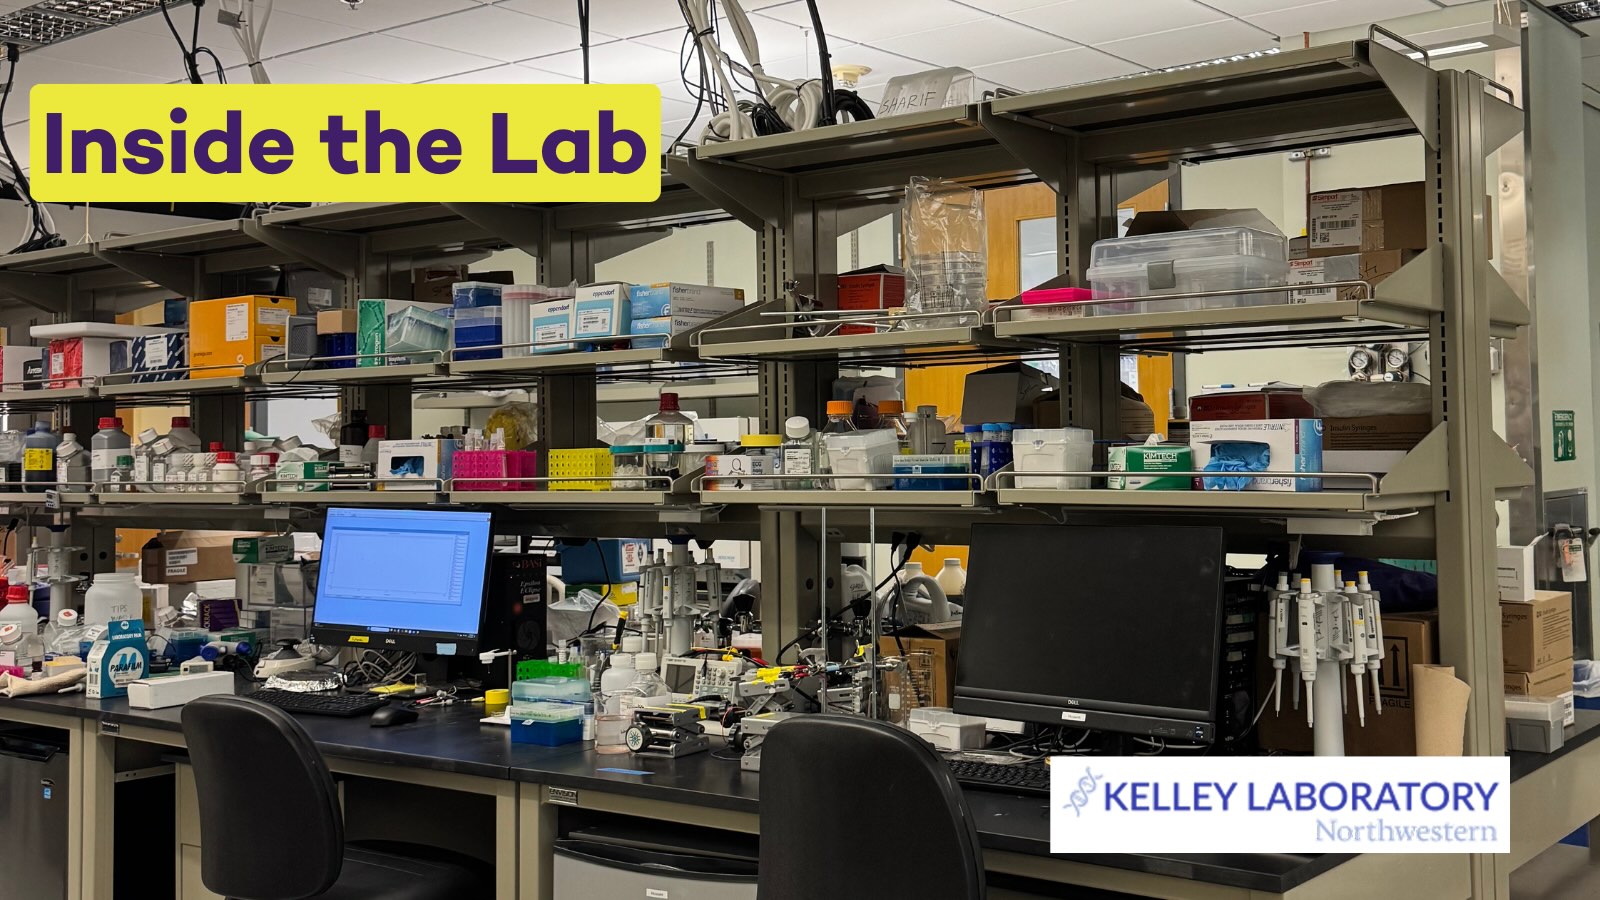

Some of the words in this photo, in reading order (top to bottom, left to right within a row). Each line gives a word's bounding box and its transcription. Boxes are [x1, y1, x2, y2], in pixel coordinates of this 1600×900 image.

[879, 91, 937, 115] SHARIF
[592, 289, 615, 298] eppendorf
[672, 286, 701, 295] fisherbrand
[547, 304, 570, 313] eppendorf
[1143, 452, 1177, 460] KIMTECH
[109, 661, 142, 672] PARAFILM
[1369, 696, 1411, 709] FAGILE
